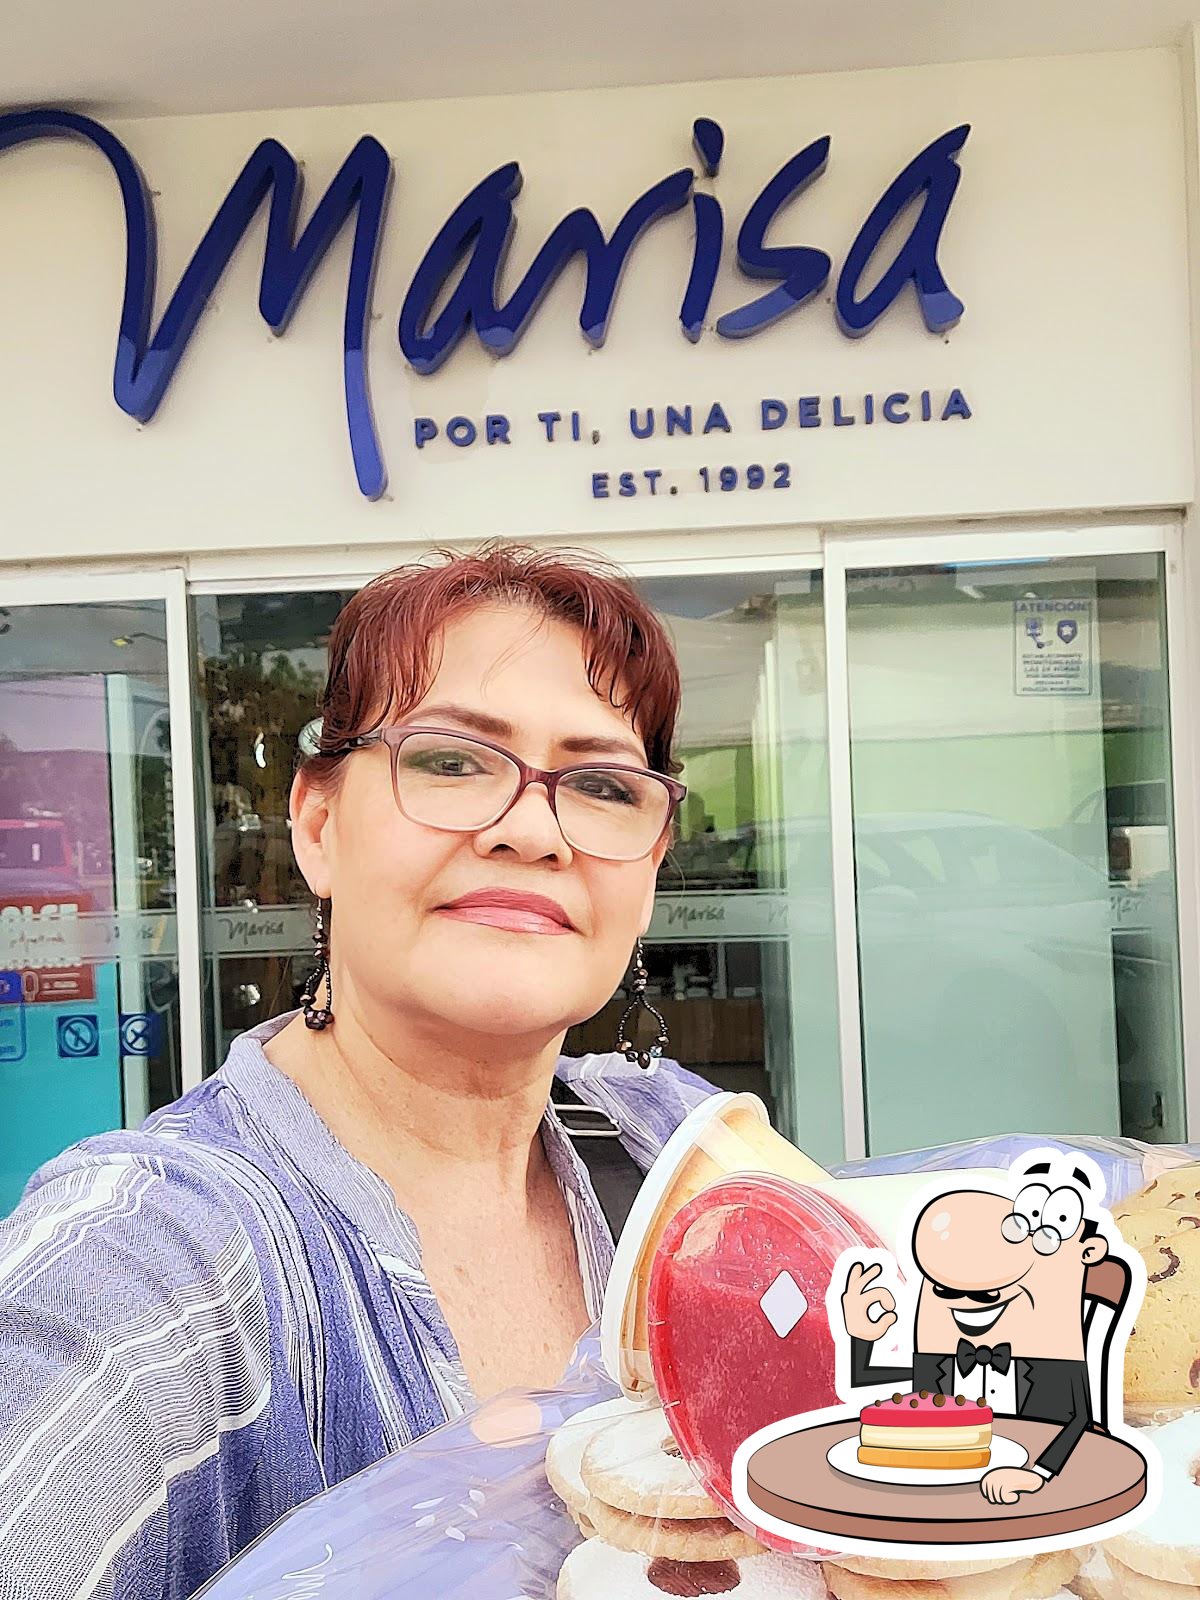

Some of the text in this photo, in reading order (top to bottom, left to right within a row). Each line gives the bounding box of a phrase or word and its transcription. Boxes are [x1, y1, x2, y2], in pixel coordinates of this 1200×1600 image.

[0, 109, 971, 502] Marisa
[414, 414, 511, 449] POR
[629, 402, 731, 439] UNA
[760, 388, 972, 431] DELICIA
[592, 462, 792, 498] EST. 1992
[218, 918, 284, 945] Marisa
[657, 902, 725, 930] Marisa
